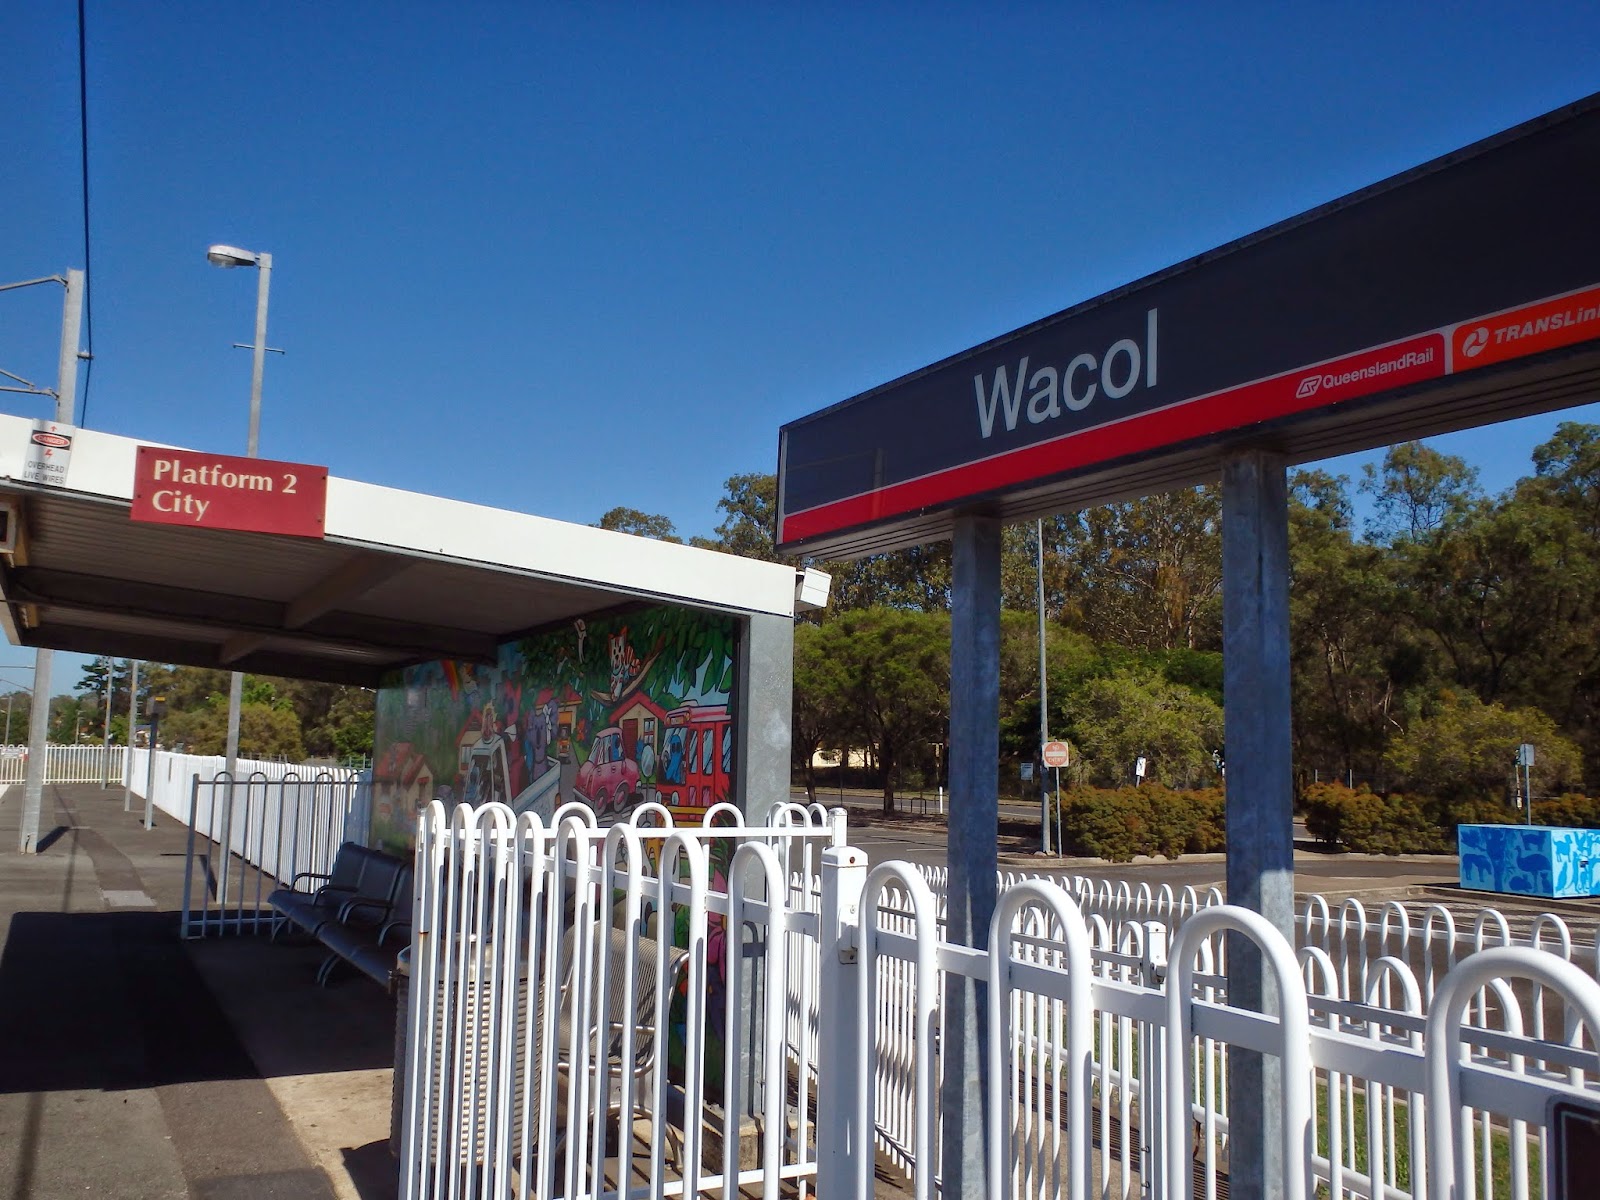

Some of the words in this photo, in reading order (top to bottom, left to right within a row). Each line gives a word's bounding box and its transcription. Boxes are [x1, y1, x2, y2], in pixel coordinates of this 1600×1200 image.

[974, 308, 1157, 438] Wacol
[1323, 347, 1433, 389] QueenslandRail
[37, 434, 66, 445] DANGER
[24, 471, 39, 480] LIVE
[43, 474, 64, 484] WIRES
[28, 460, 64, 473] OVERHEAD
[154, 459, 272, 491] Platform
[282, 474, 297, 494] 2
[152, 490, 210, 521] City
